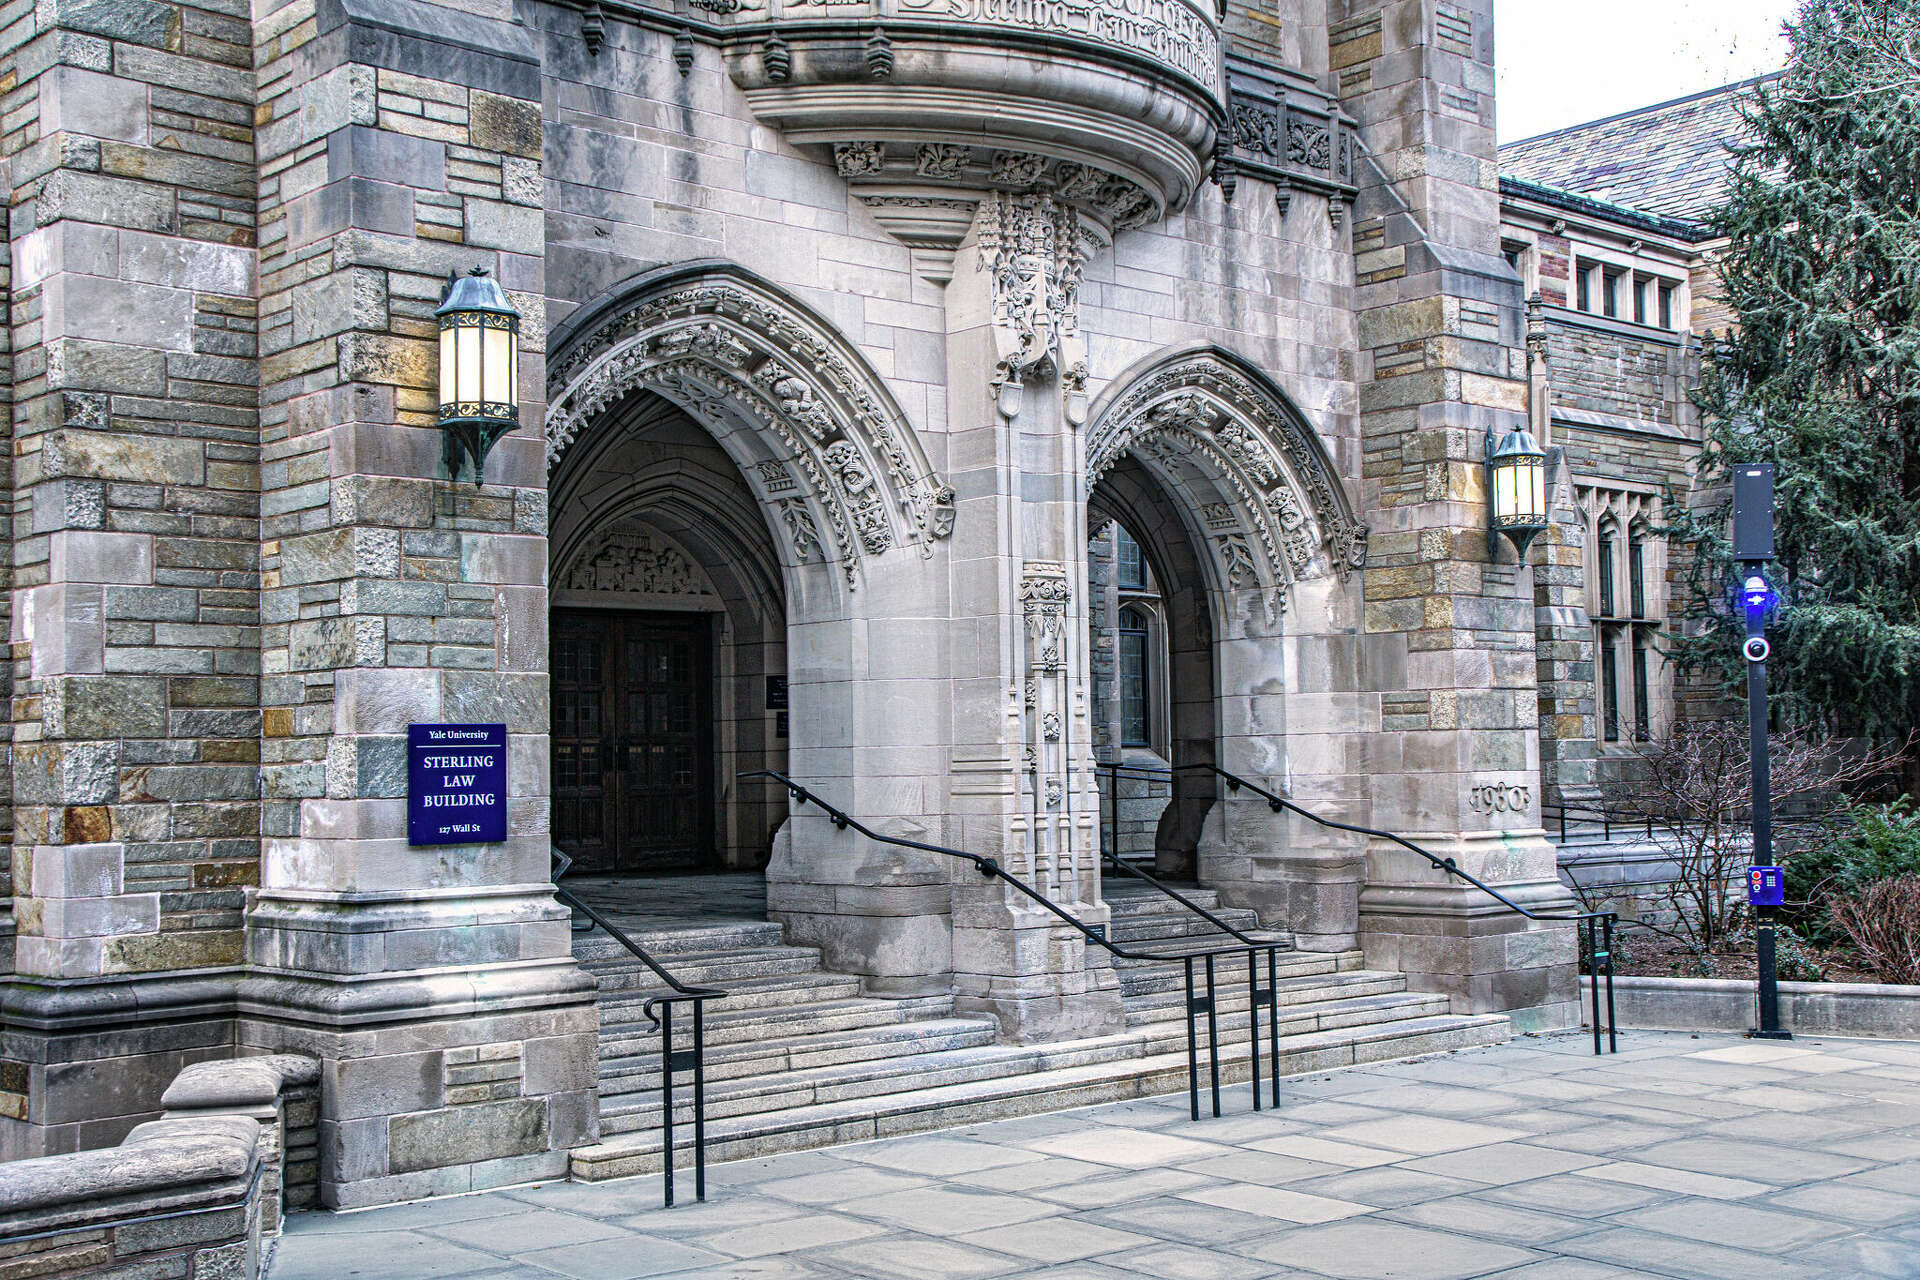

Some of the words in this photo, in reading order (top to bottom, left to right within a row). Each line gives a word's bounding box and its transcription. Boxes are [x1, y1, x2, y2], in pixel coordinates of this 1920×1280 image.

[429, 731, 446, 739] Yale
[447, 730, 489, 740] University
[423, 755, 494, 768] STERLING
[443, 775, 475, 787] LAW
[423, 793, 495, 807] BUILDING
[1476, 781, 1523, 815] 1930
[439, 826, 451, 834] 127
[452, 824, 470, 833] Wall
[471, 824, 481, 832] St
